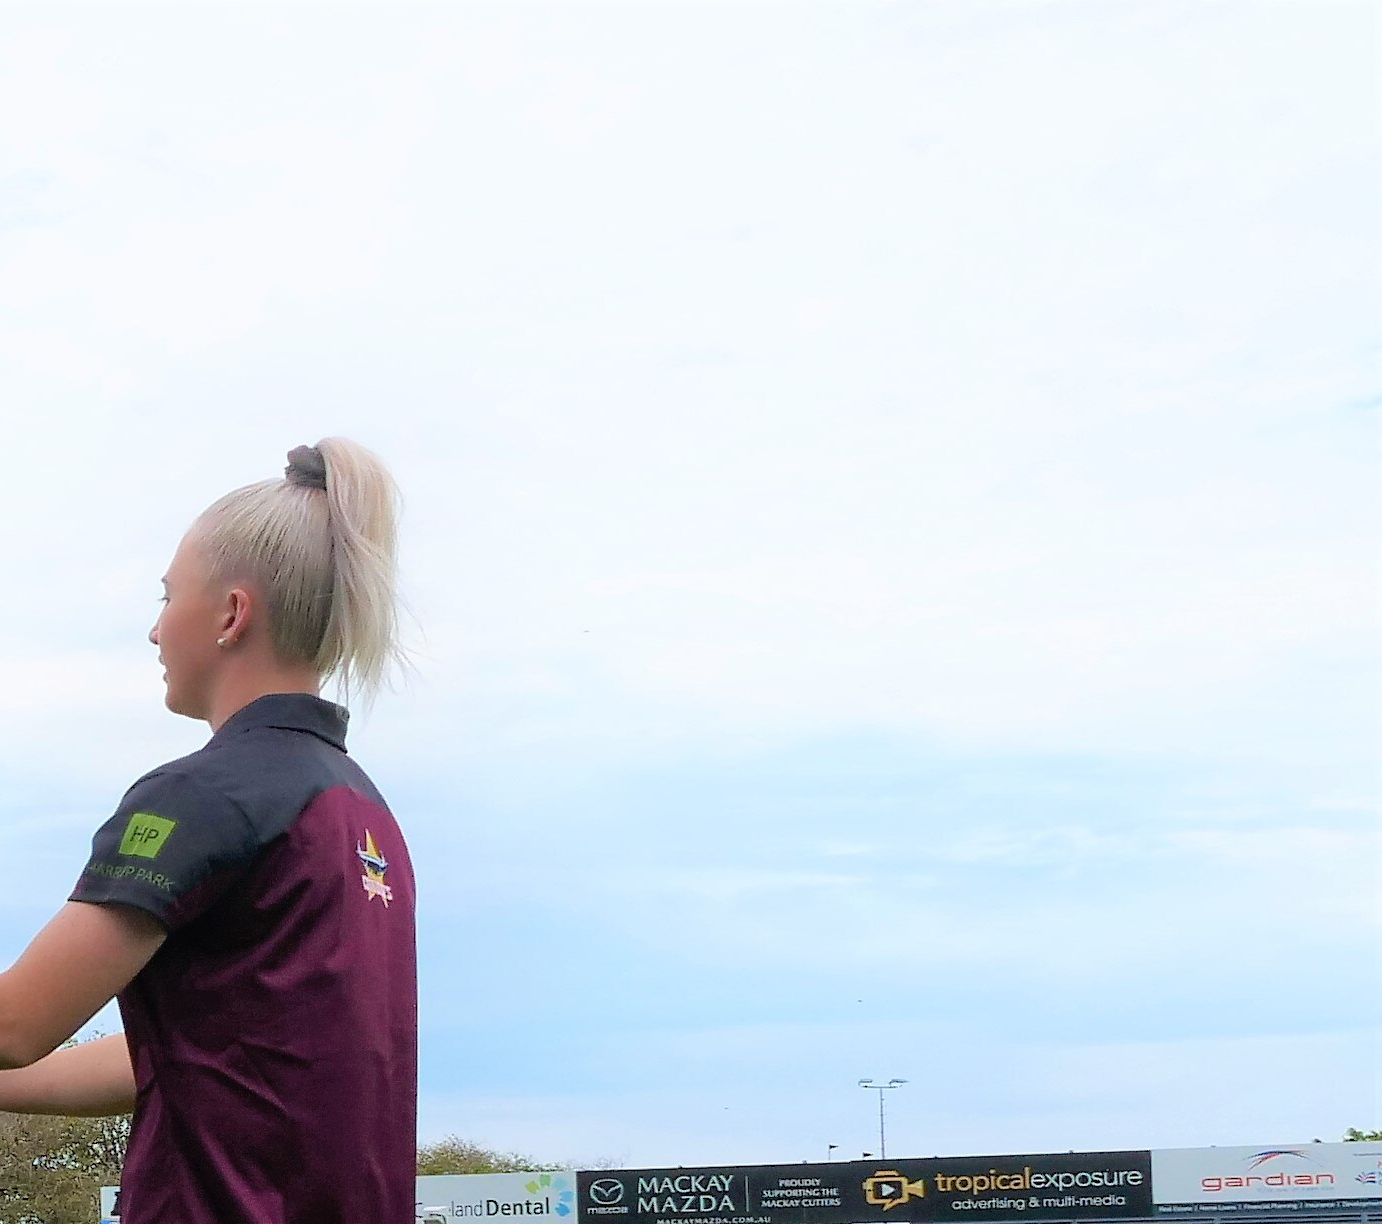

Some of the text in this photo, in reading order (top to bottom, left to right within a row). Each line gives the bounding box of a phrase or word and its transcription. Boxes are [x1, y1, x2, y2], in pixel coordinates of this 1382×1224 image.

[129, 825, 159, 843] HP
[135, 868, 176, 891] PARK
[637, 1175, 734, 1194] MACKAY
[778, 1179, 821, 1187] PROUDLY
[935, 1167, 1143, 1195] tropicalexposure
[1201, 1173, 1334, 1191] gardian
[763, 1188, 839, 1198] SUPPORTING THE
[637, 1196, 735, 1213] MAZDA
[761, 1197, 841, 1207] MACKAY CUTTERS
[952, 1195, 1125, 1211] advertising & multi-media
